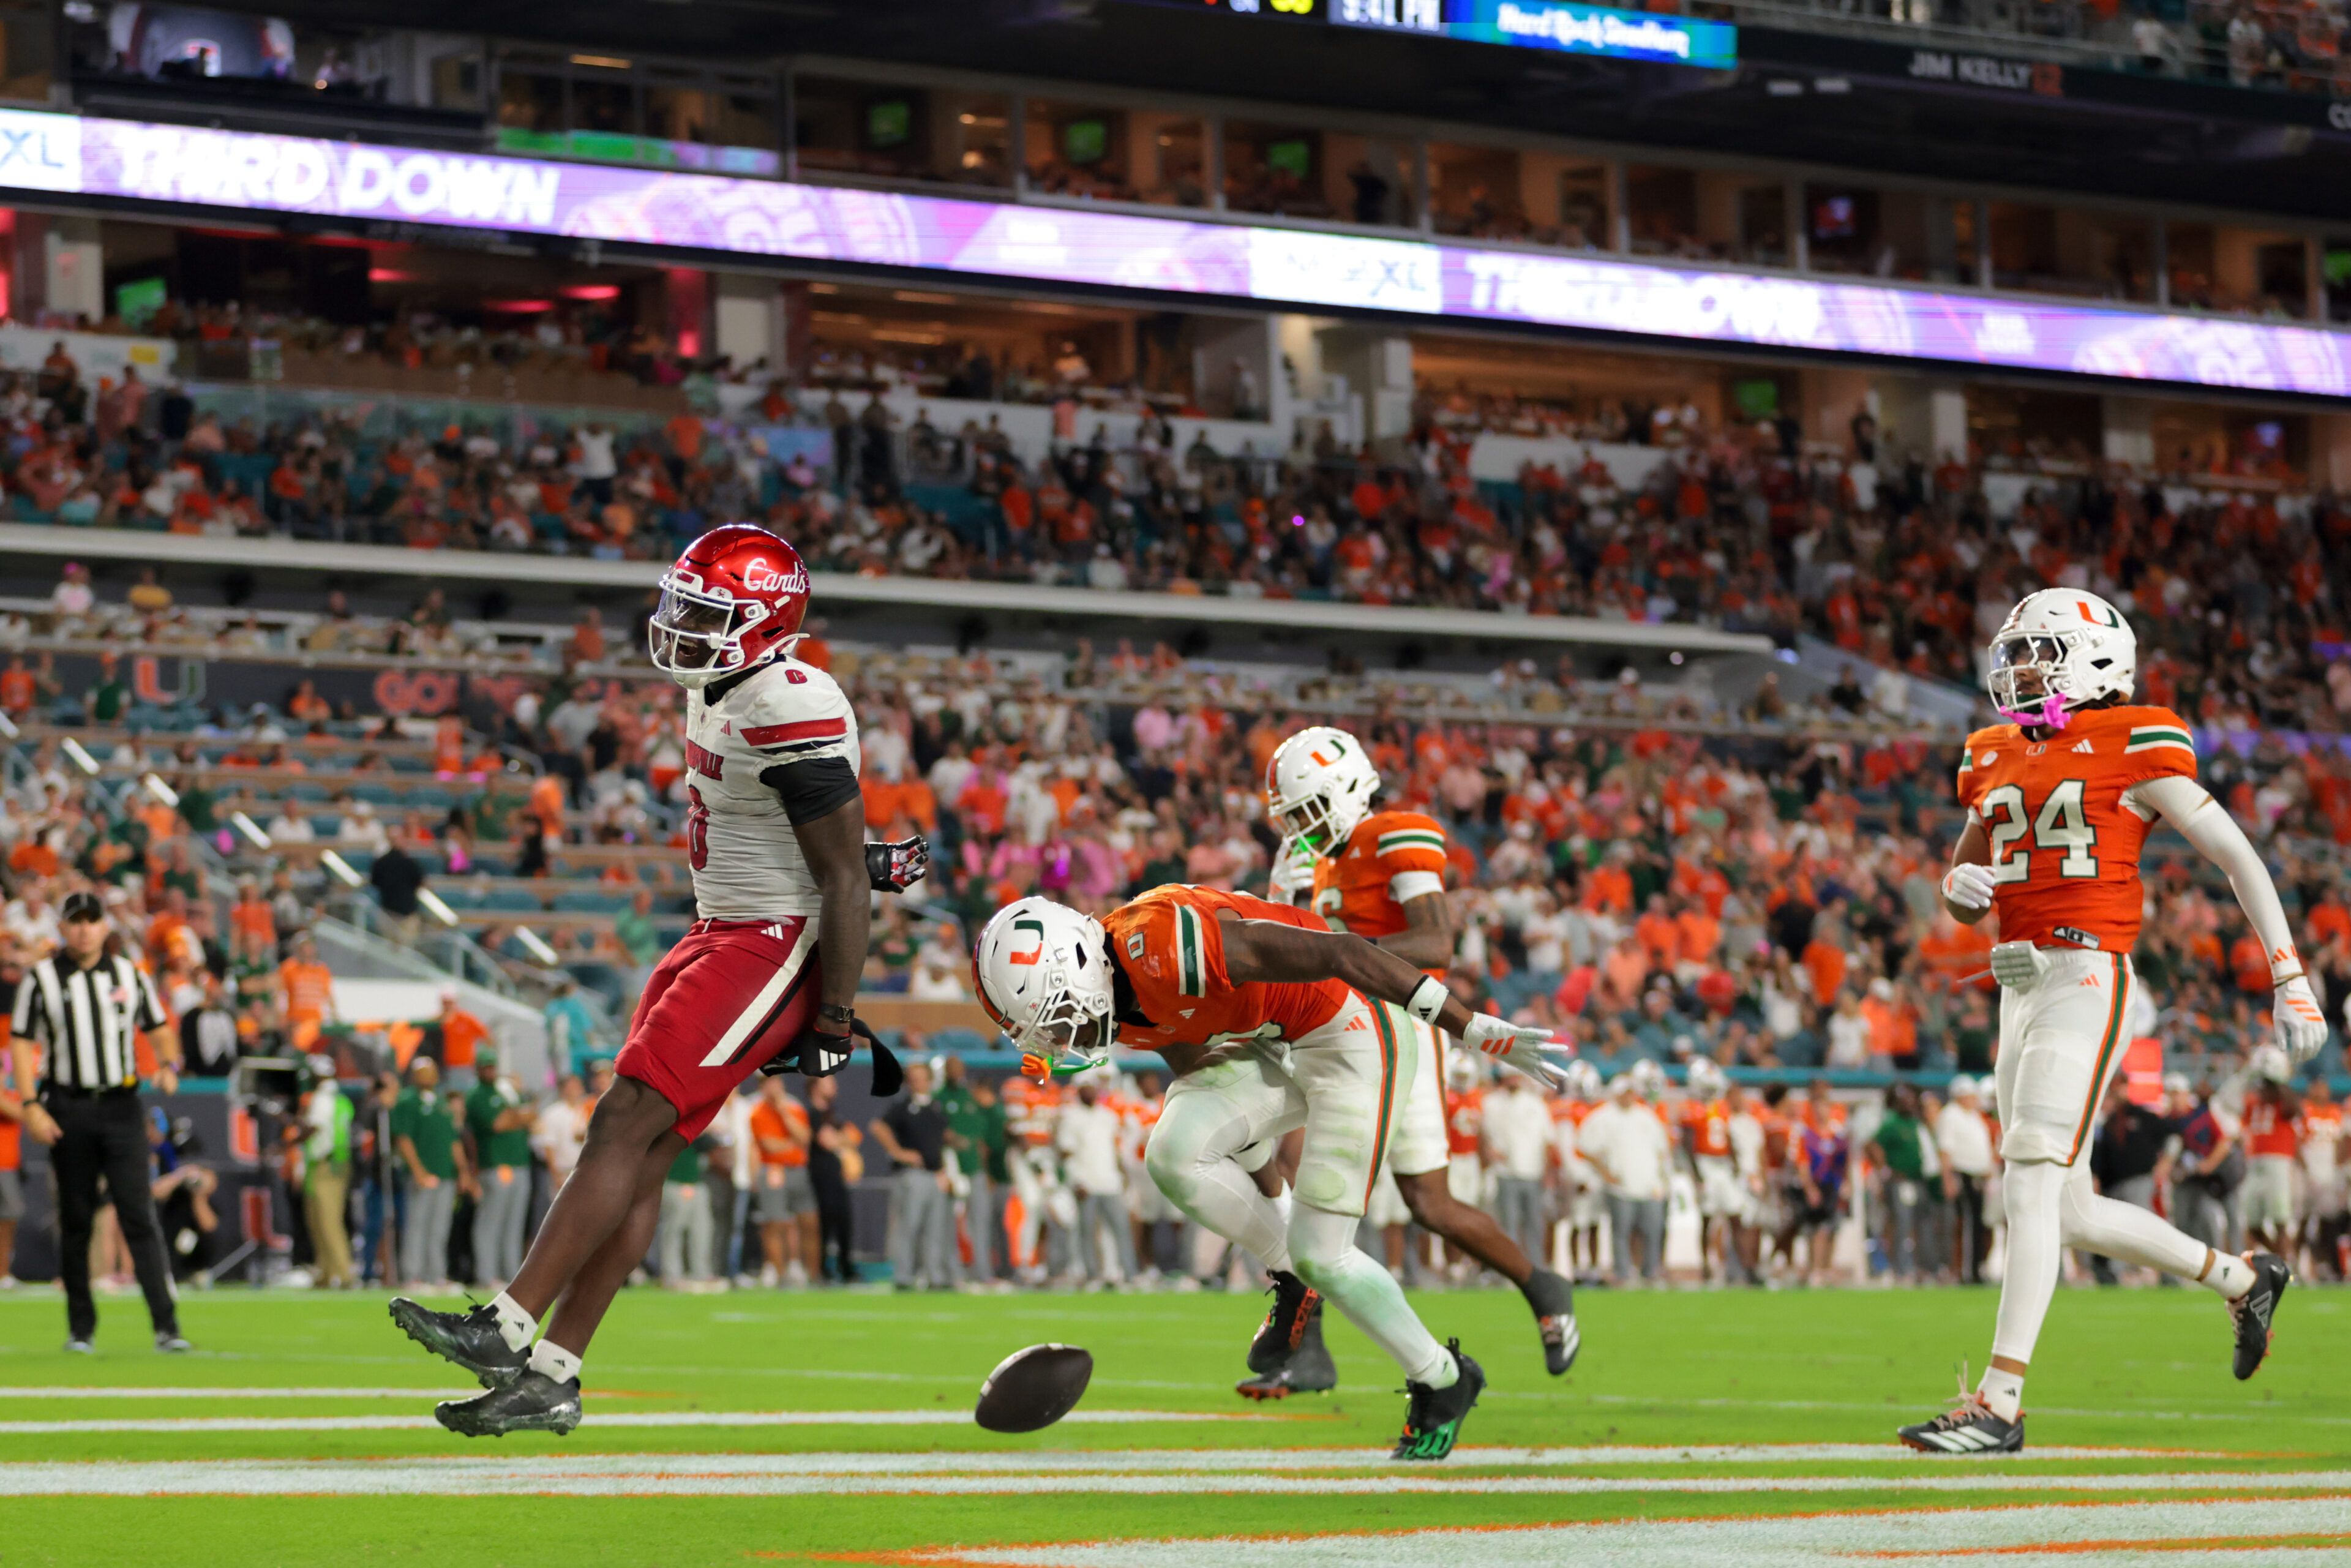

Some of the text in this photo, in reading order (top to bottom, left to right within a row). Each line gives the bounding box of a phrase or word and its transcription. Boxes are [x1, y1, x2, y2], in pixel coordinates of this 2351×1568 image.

[1908, 51, 1953, 80] JIM
[1957, 57, 2031, 88] KELLY
[112, 124, 561, 225] THIRD DOWN
[744, 558, 806, 594] Cards
[2076, 601, 2120, 629] U
[133, 655, 207, 705] U
[1310, 739, 1346, 768] U
[1982, 778, 2099, 884] 24
[1010, 920, 1044, 966] U
[1127, 931, 1145, 961] 0
